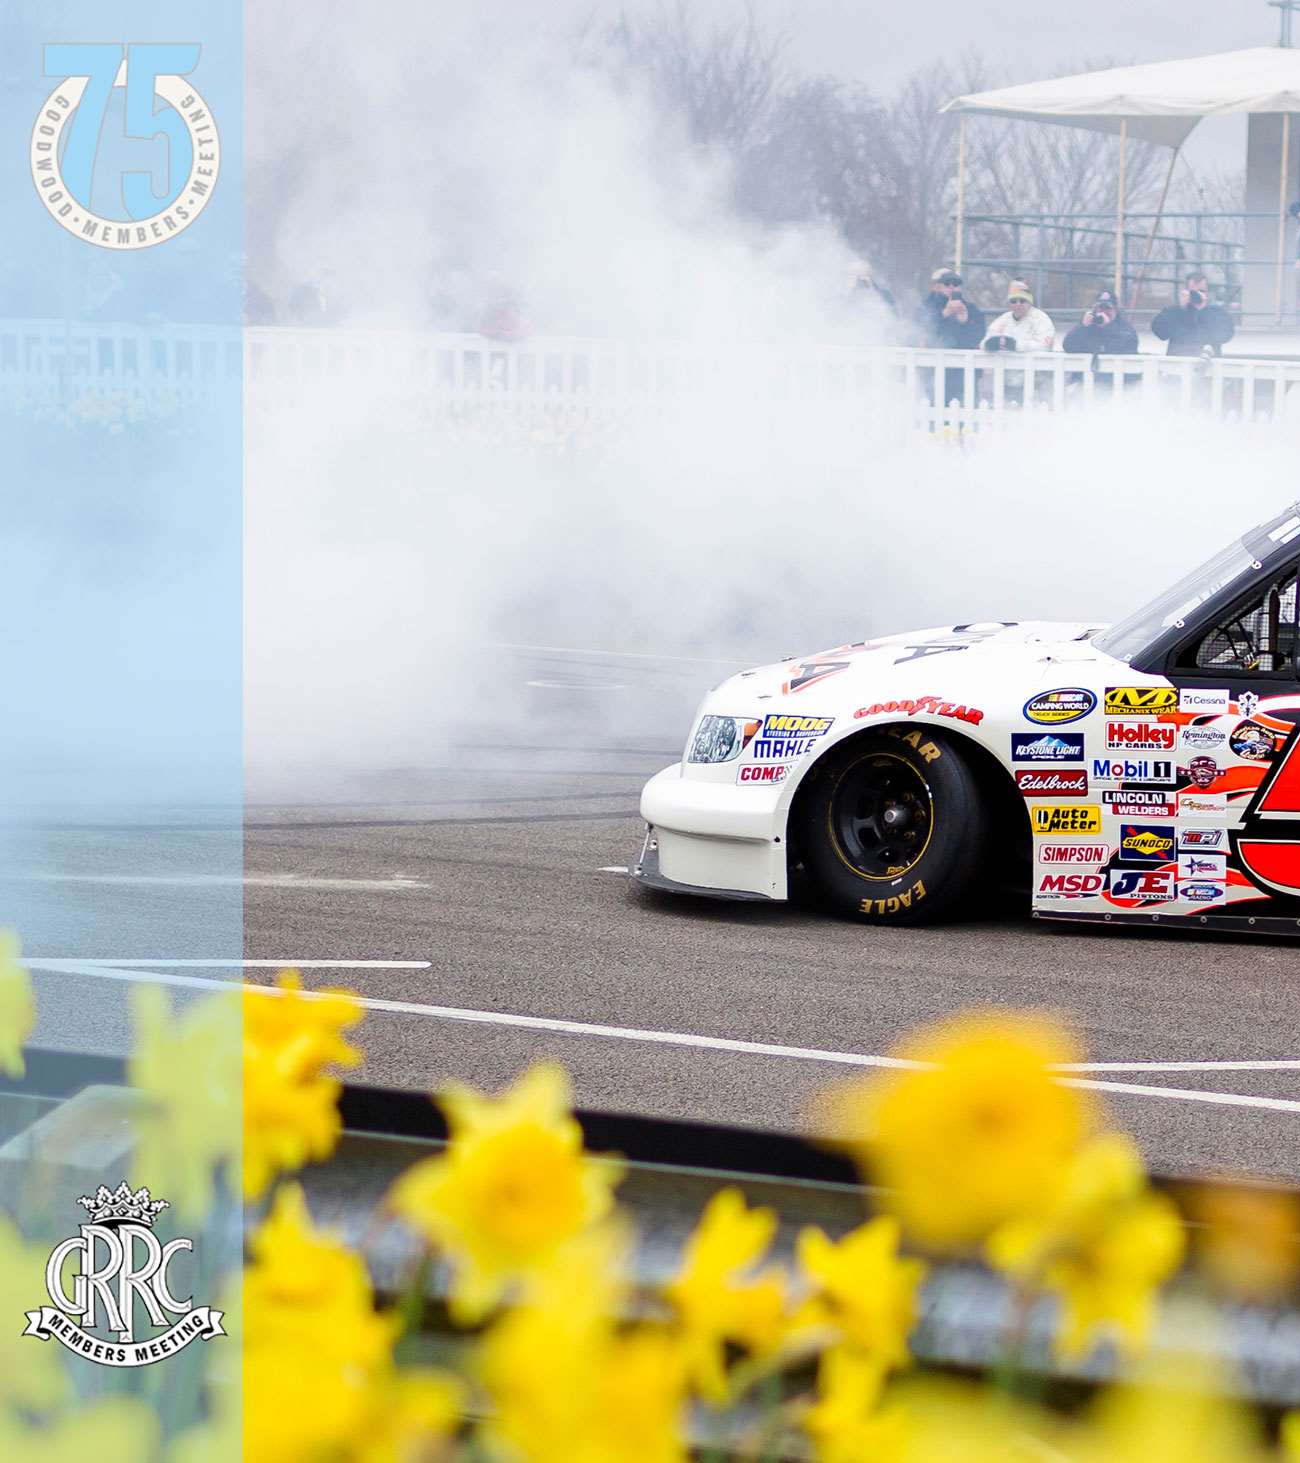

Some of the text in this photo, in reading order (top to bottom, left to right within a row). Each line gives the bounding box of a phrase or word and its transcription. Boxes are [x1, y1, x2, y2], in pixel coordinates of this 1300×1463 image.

[1031, 702, 1090, 710] CAMPING WORLD
[1193, 695, 1226, 705] Cessna
[854, 696, 985, 727] GOODYEAR
[1105, 705, 1177, 714] MECHANIX WEAR
[765, 715, 831, 731] MOOG
[1108, 723, 1174, 749] Holley
[753, 738, 817, 758] MAHLE
[1016, 744, 1081, 756] KEYSTONE LIGHT
[740, 766, 785, 781] COMP
[1093, 759, 1148, 778] Mobil
[1018, 774, 1087, 790] Edelbrock
[1104, 792, 1163, 804] LINCOLN
[1051, 808, 1089, 819] Auto
[1117, 805, 1169, 815] WELDERS
[1050, 819, 1097, 830] Meter
[1125, 838, 1174, 849] SUNOCO
[1043, 846, 1104, 862] SIMPSON
[1039, 874, 1102, 892] MSD
[1112, 872, 1171, 896] JE
[858, 879, 928, 915] EAGLE
